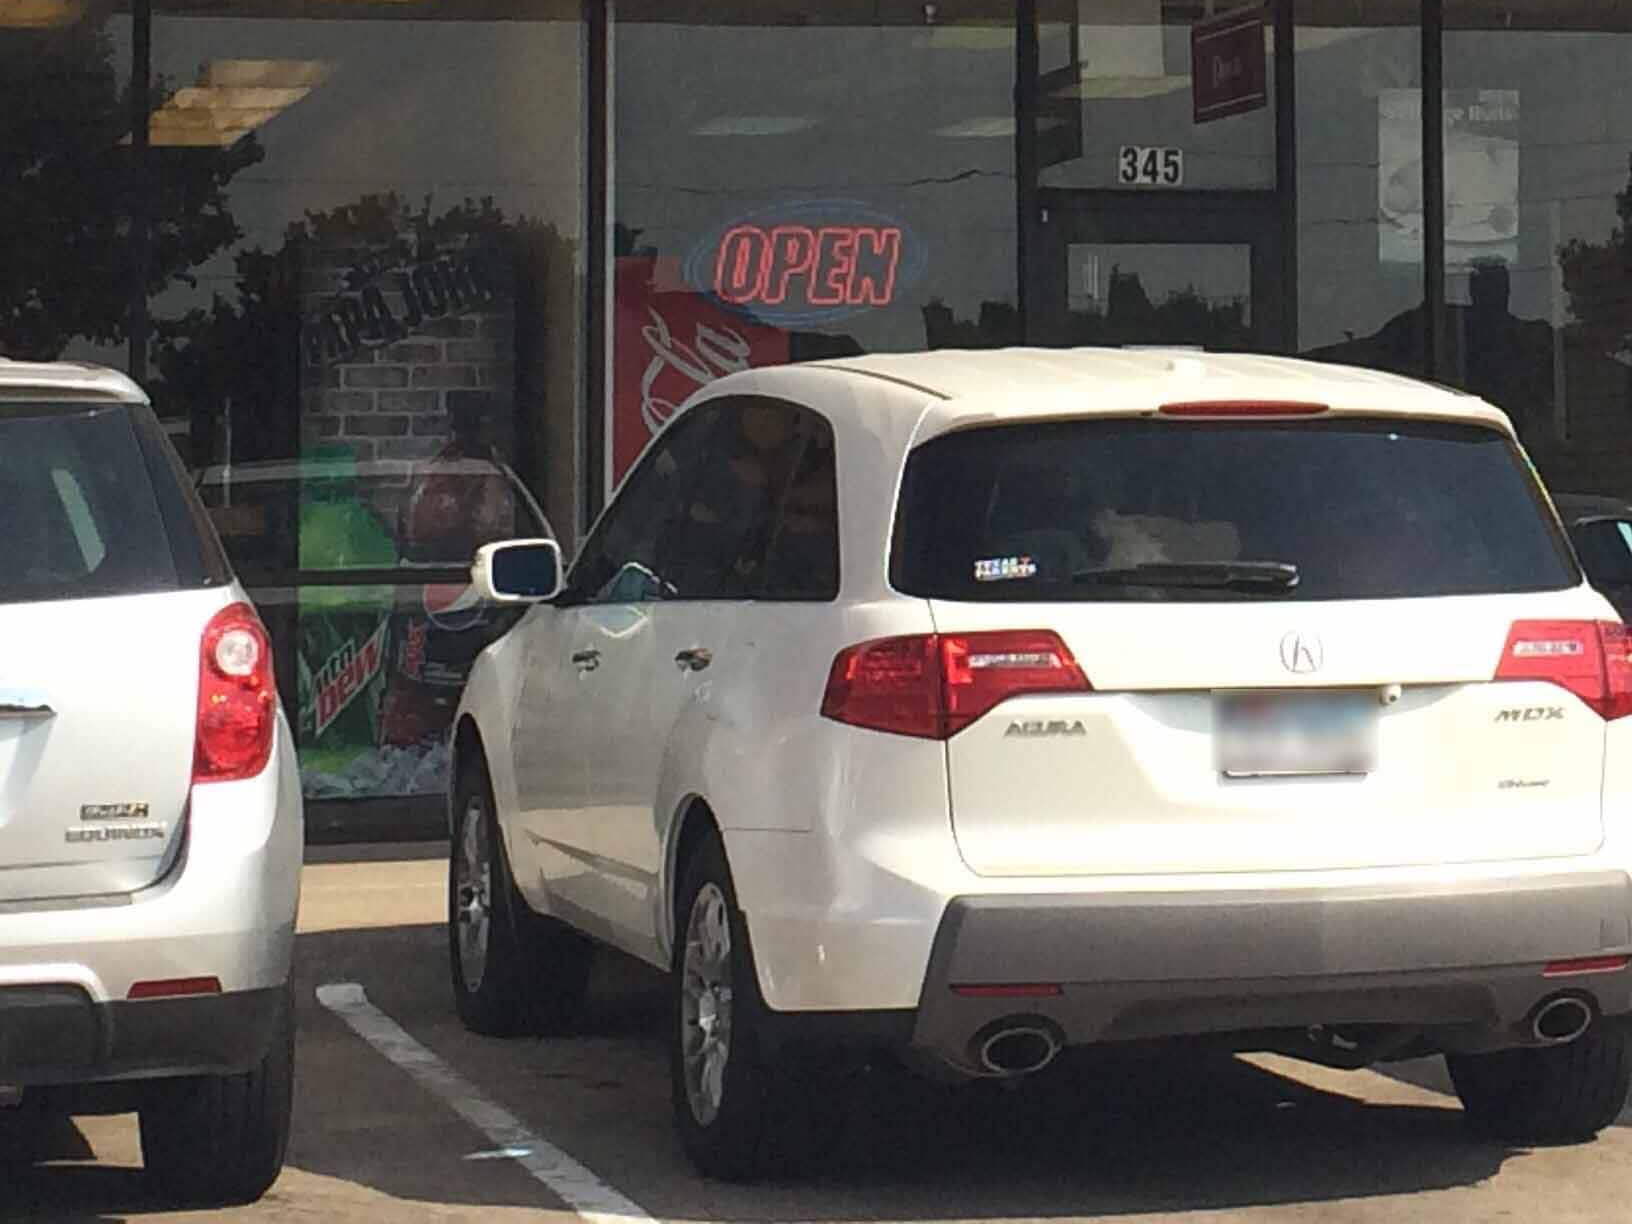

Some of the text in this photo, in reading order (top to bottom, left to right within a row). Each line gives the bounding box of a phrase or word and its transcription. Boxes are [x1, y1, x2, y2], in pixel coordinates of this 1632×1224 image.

[1121, 146, 1181, 184] 345
[713, 225, 902, 305] OPEN
[1494, 706, 1567, 722] MDX
[1004, 720, 1087, 737] ACURA
